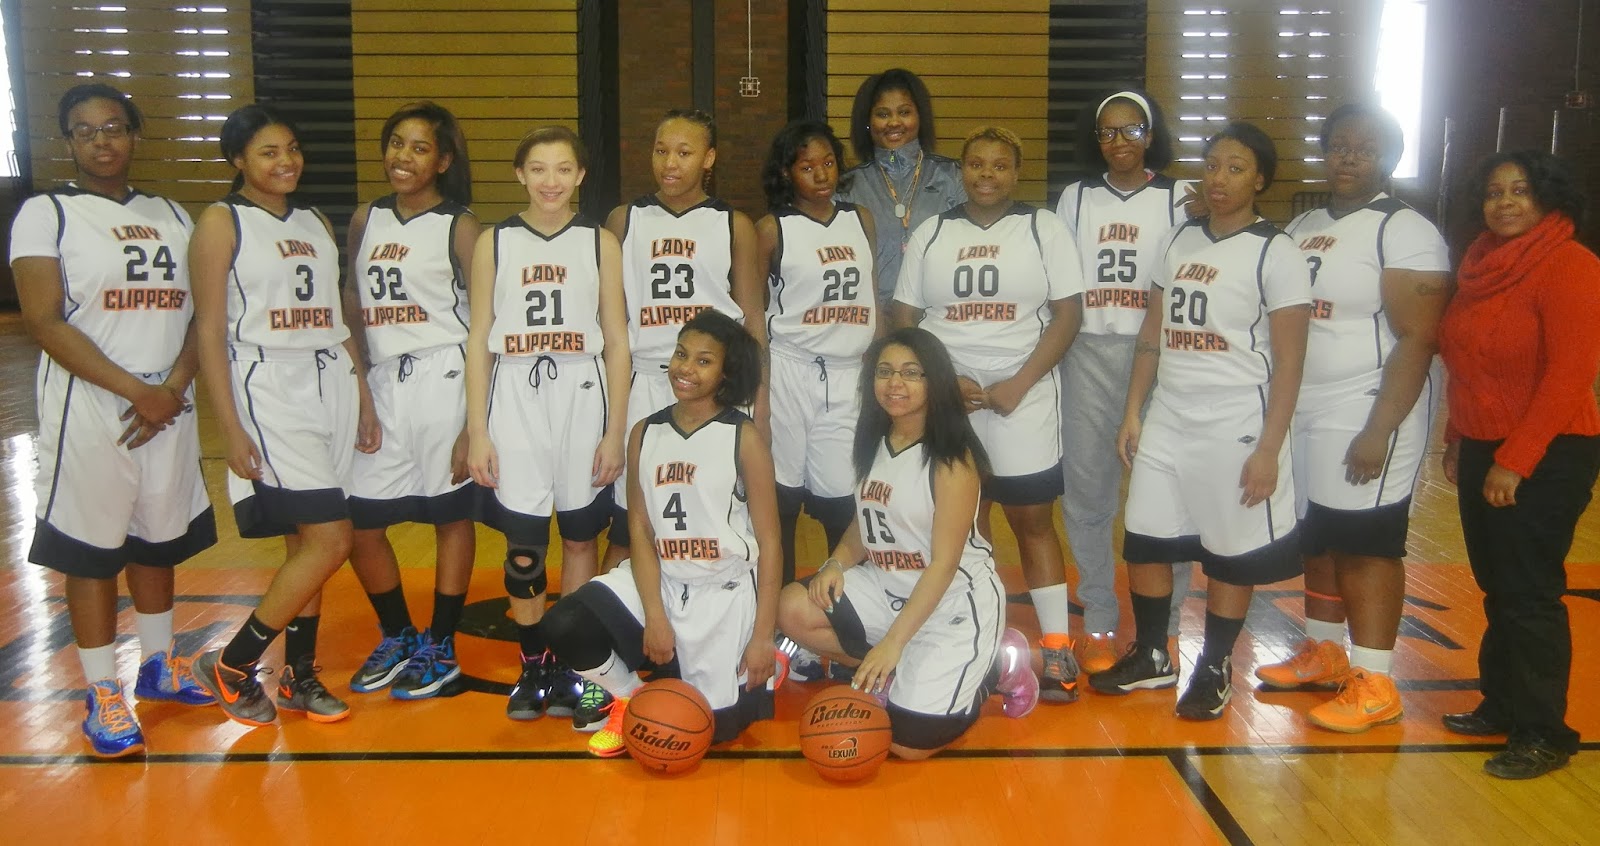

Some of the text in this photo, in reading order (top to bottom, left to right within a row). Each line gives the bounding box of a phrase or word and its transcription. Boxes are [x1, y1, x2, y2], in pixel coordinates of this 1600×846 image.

[111, 224, 163, 242] LADY
[1098, 222, 1140, 244] LADY
[1299, 235, 1338, 253] LADY
[275, 239, 318, 259] LADY
[369, 243, 411, 262] LADY
[650, 237, 697, 260] LADY
[816, 245, 857, 266] LADY
[956, 245, 1000, 263] LADY
[123, 245, 177, 282] 24
[521, 263, 567, 288] LADY
[1097, 248, 1137, 283] 25
[1173, 262, 1219, 286] LADY
[295, 264, 314, 301] 3
[367, 265, 408, 301] 32
[650, 263, 695, 299] 23
[822, 266, 860, 302] 22
[953, 264, 999, 298] 00
[103, 288, 188, 312] CLIPPERS
[525, 289, 564, 326] 21
[1170, 286, 1208, 326] 20
[269, 307, 334, 331] CLIPPER
[640, 304, 714, 328] CLIPPE
[801, 305, 870, 326] CLIPPERS
[504, 331, 586, 356] CLIPPERS
[1163, 328, 1230, 353] LIPPERS
[655, 461, 697, 488] LADY
[861, 479, 893, 507] LADY
[662, 492, 687, 531] 4
[862, 507, 896, 544] 15
[655, 537, 721, 561] LIPPERS
[865, 547, 928, 572] LIPPERS
[828, 748, 858, 760] LEXUM
